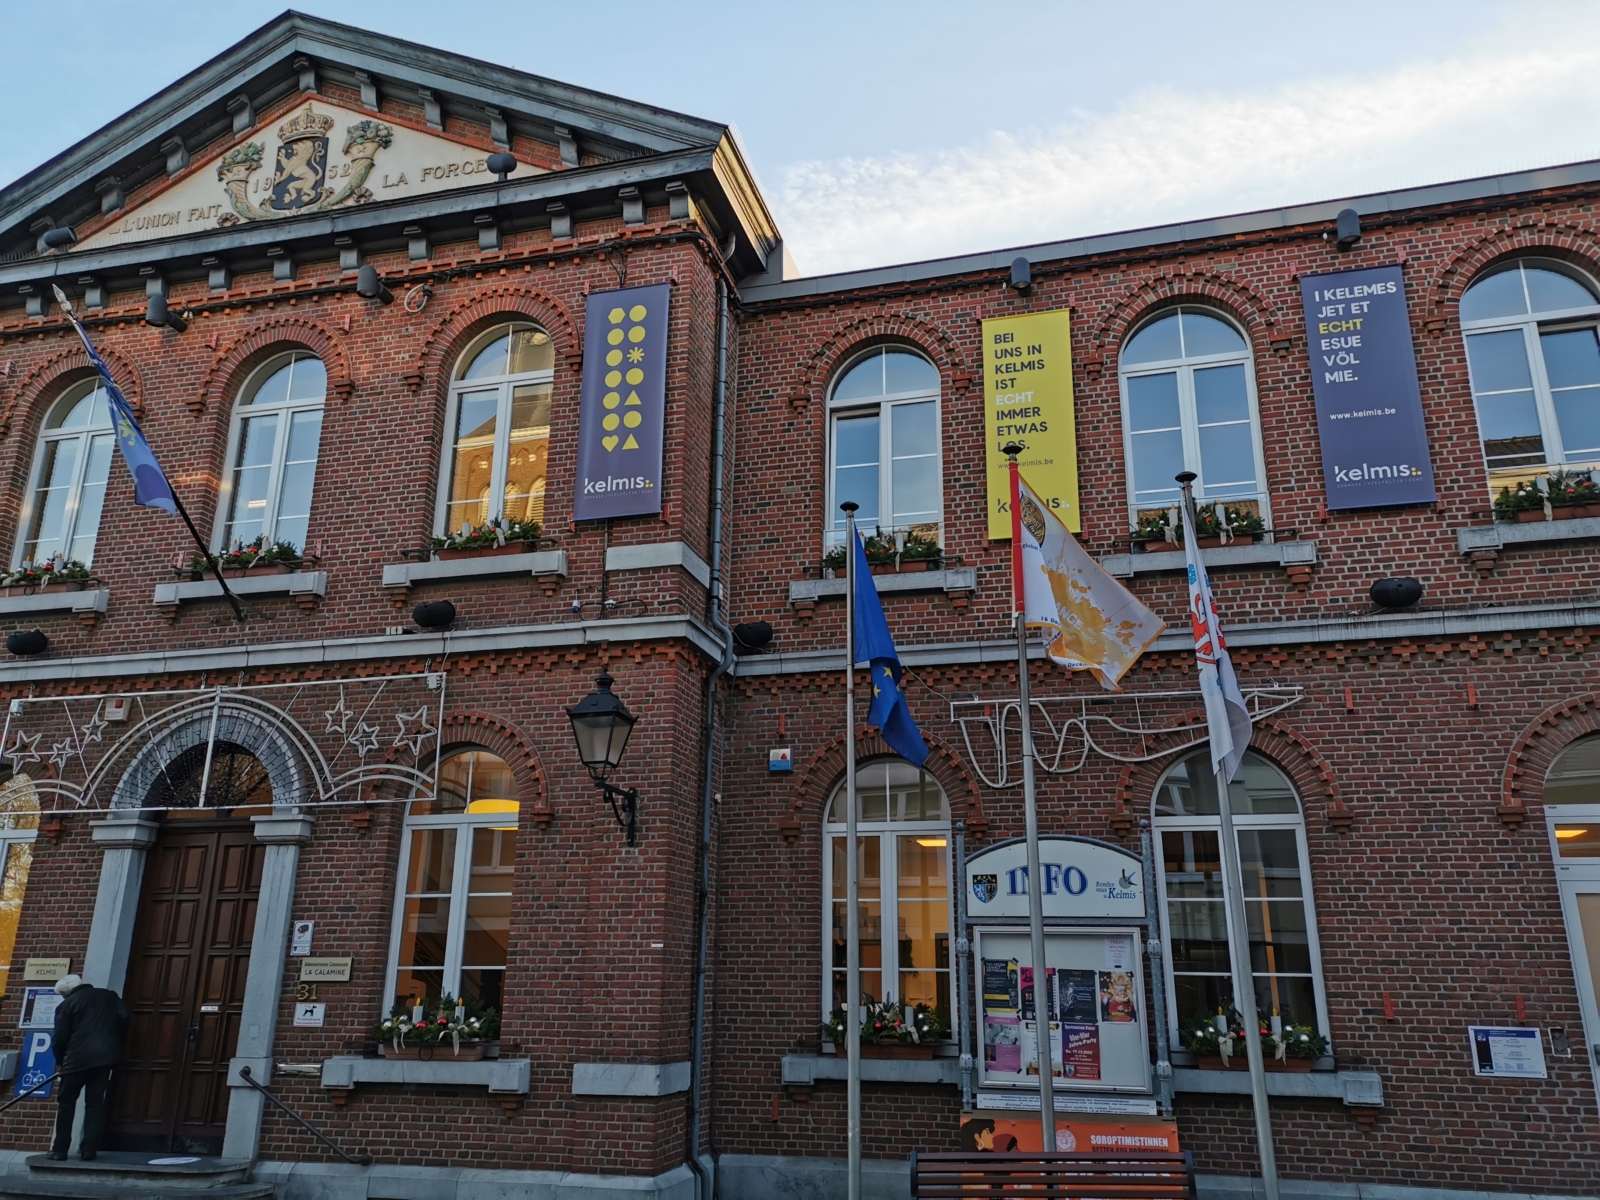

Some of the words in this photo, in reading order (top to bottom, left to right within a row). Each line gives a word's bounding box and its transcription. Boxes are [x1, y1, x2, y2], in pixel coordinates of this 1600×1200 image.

[252, 177, 273, 194] 19
[327, 162, 351, 180] 52
[187, 204, 223, 222] FAIT
[381, 172, 408, 189] LA
[420, 158, 488, 183] FORCE
[1314, 290, 1320, 302] I
[1323, 281, 1397, 301] KELEMES
[1317, 303, 1345, 318] JET
[1350, 301, 1370, 314] ET
[1318, 318, 1363, 334] ECHT
[994, 332, 1014, 345] BEI
[1320, 335, 1362, 351] ESUE
[994, 346, 1022, 359] UNS
[1027, 344, 1042, 356] IN
[1322, 350, 1360, 367] VÖL
[995, 359, 1045, 375] KELMIS
[995, 377, 1017, 390] IST
[1324, 369, 1358, 384] MIE.
[995, 391, 1034, 406] ECHT
[996, 406, 1041, 421] IMMER
[1329, 407, 1396, 420] www.kelmis.be
[997, 421, 1048, 436] ETWAS
[1107, 887, 1137, 900] Kelmis
[296, 984, 318, 1000] 31
[27, 1033, 52, 1067] P
[1090, 1135, 1168, 1147] SOROPTIMISTINNEN
